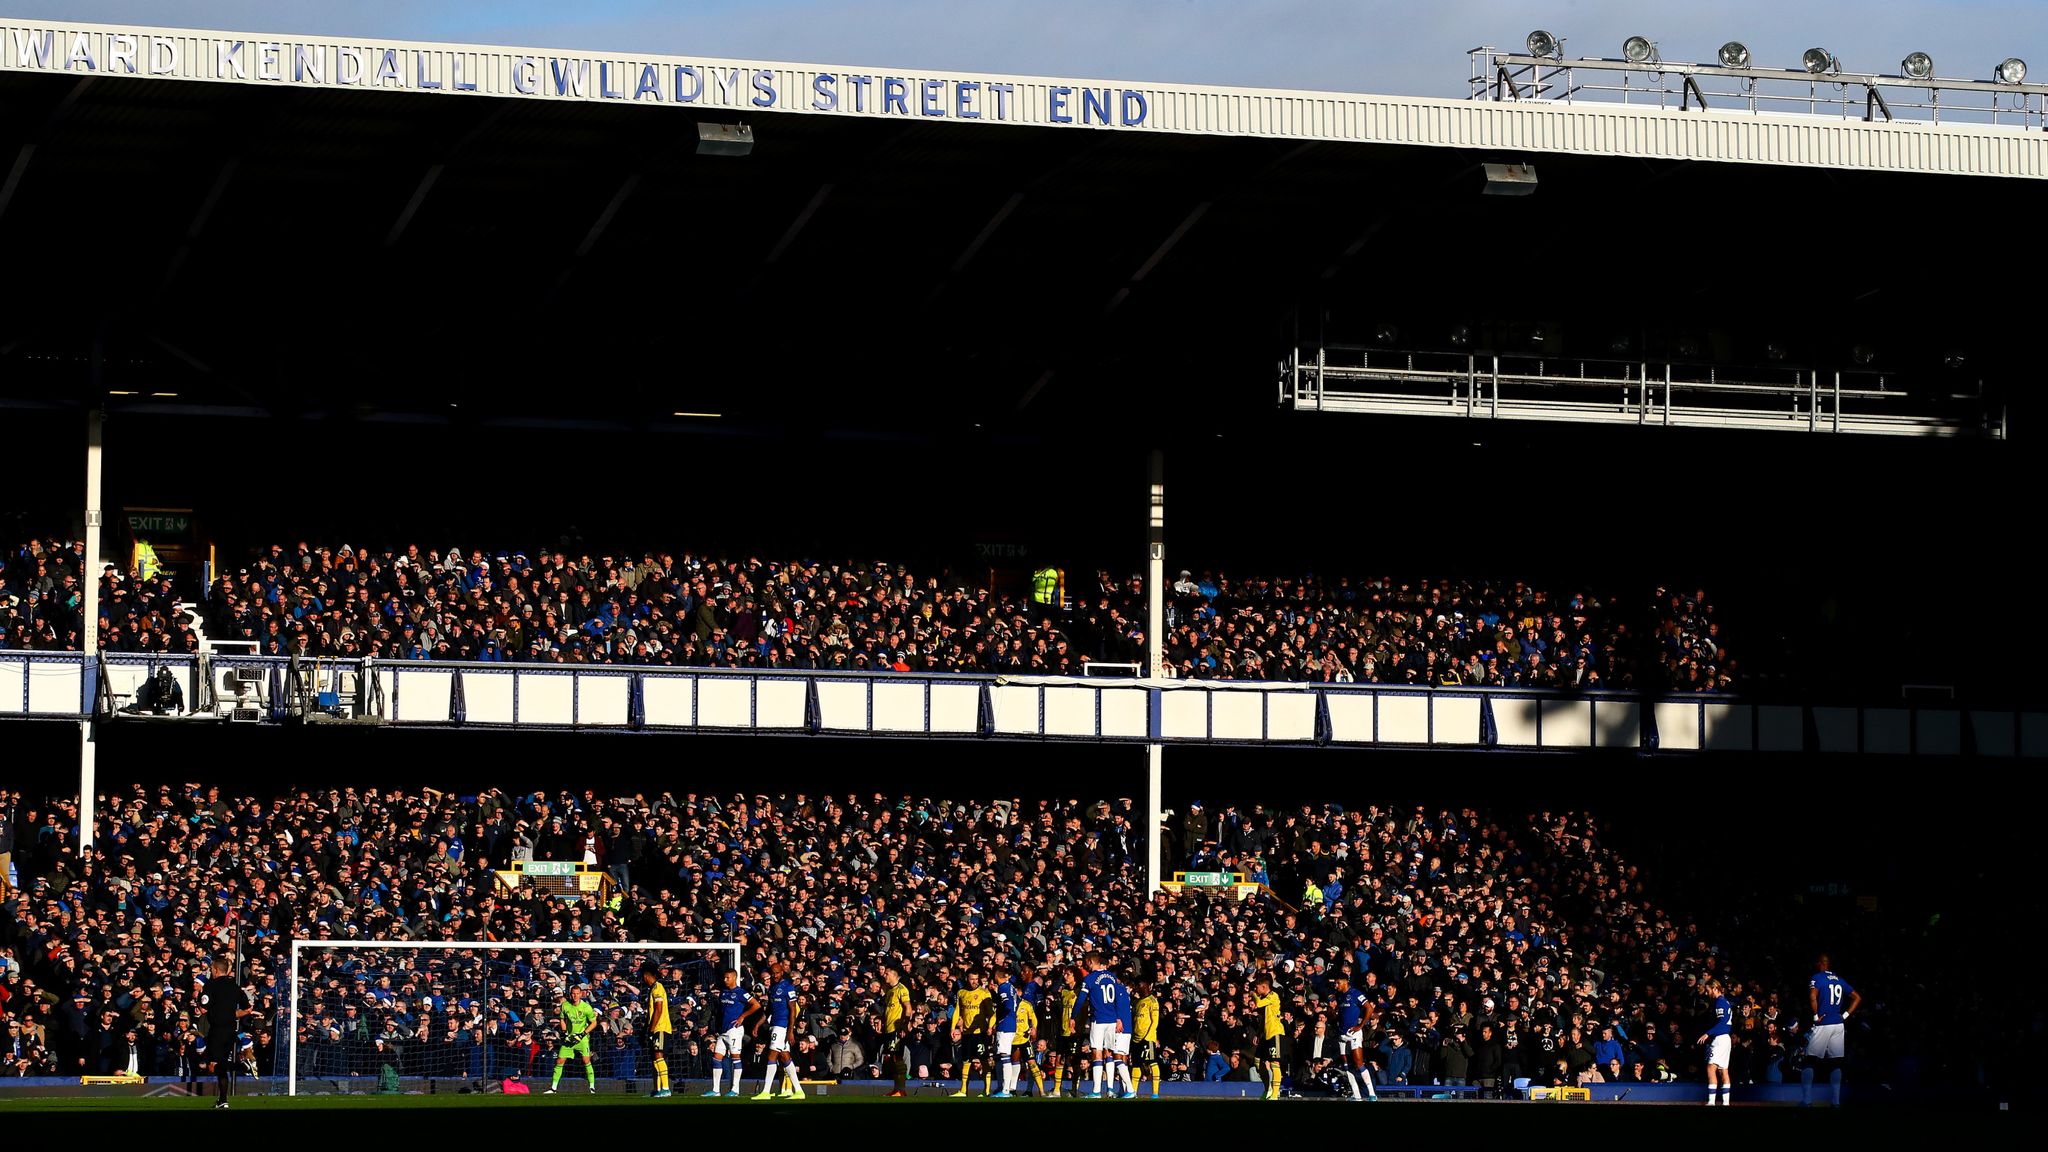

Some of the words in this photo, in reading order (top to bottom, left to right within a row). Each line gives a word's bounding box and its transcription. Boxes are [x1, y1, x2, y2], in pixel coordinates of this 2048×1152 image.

[0, 31, 179, 76] WARD
[216, 41, 478, 91] KENDALL
[512, 58, 778, 107] GWLADYS
[811, 74, 1014, 121] STREET
[1049, 87, 1149, 127] END
[128, 516, 162, 531] EXIT
[1152, 544, 1162, 560] J
[528, 864, 548, 873] EXIT
[1189, 875, 1209, 883] EXIT
[1100, 983, 1115, 1004] 10
[1828, 983, 1843, 1006] 19
[731, 1038, 737, 1047] 7
[770, 1032, 778, 1042] 8
